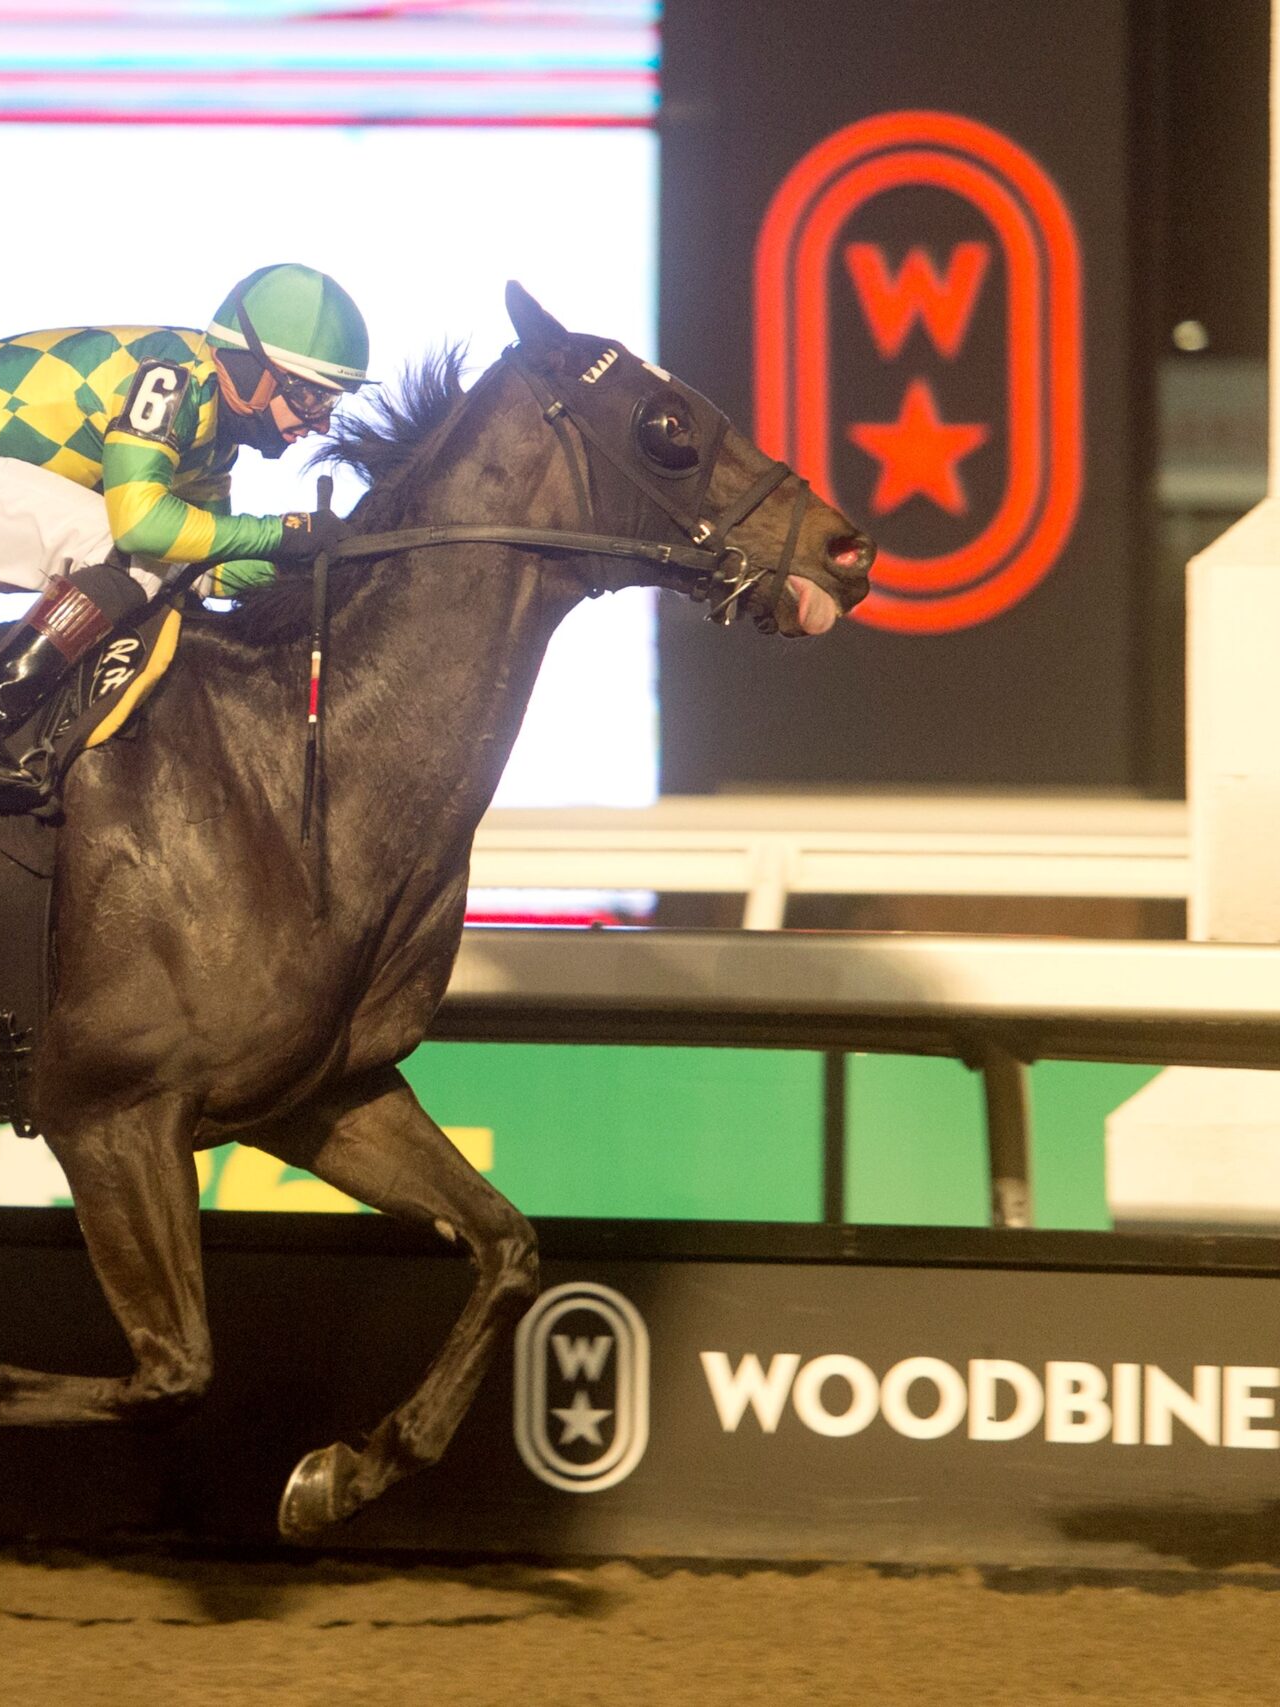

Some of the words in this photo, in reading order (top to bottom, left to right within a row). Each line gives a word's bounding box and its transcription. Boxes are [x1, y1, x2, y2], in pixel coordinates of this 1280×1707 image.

[844, 242, 991, 358] W
[129, 366, 178, 433] 6
[551, 1335, 613, 1382] W
[699, 1351, 1280, 1449] WOODBINE
